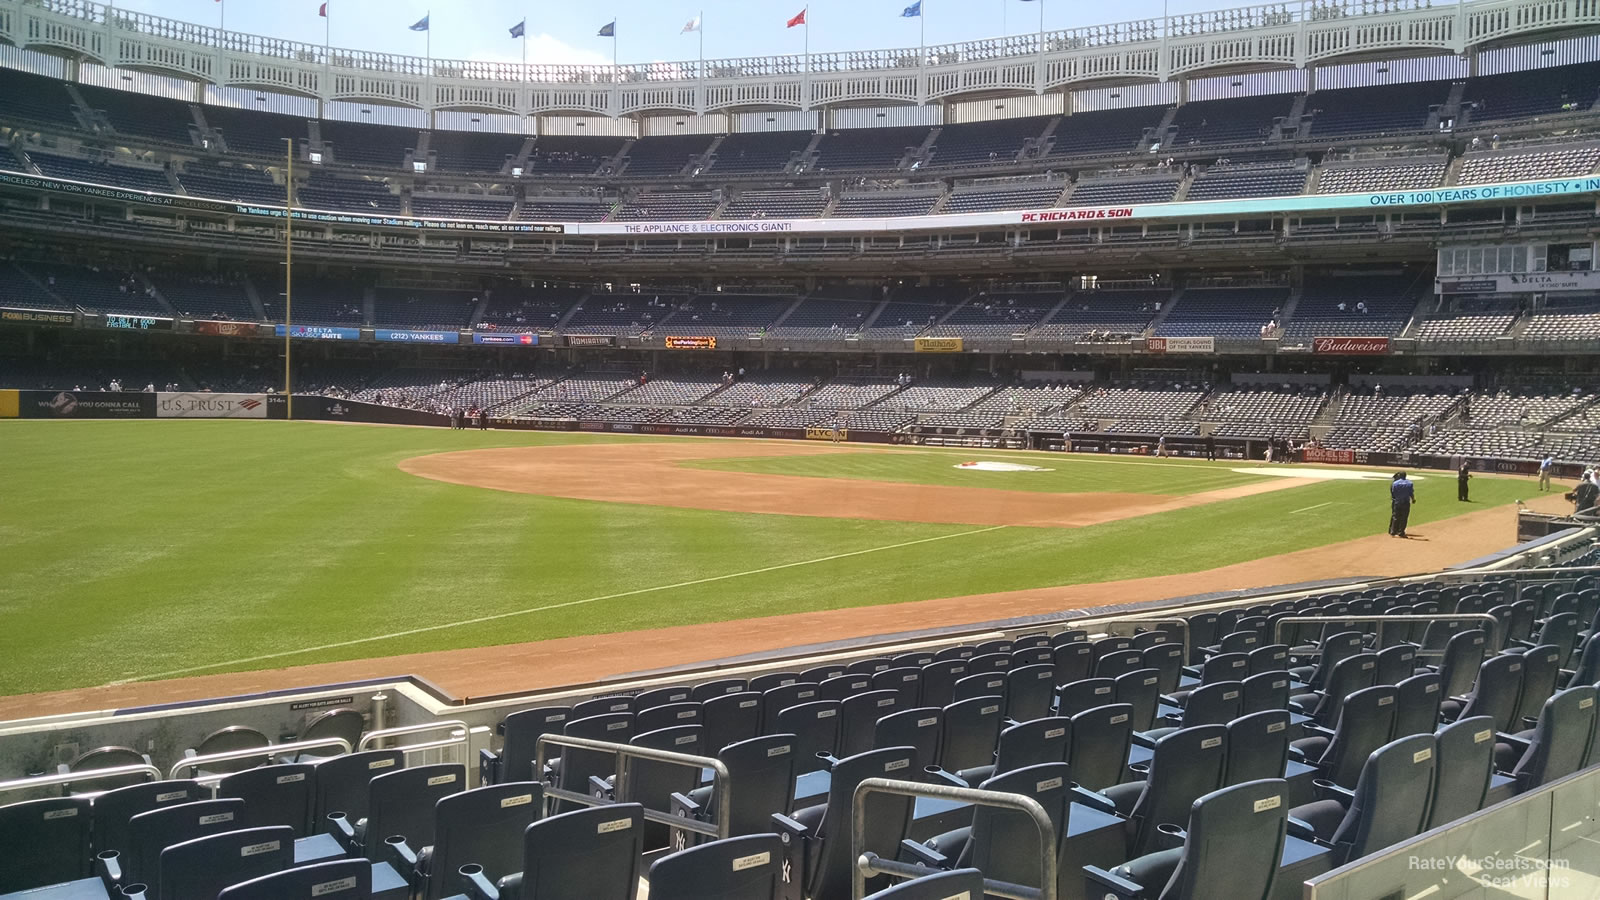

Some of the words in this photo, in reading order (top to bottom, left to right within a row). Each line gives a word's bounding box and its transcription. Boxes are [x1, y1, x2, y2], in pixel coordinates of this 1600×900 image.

[42, 180, 61, 189] NEW
[62, 182, 82, 192] YORK
[83, 185, 116, 198] YANKEES
[116, 191, 163, 204] EXPERIENCES
[163, 198, 173, 206] AT
[1370, 194, 1405, 206] OVER
[1408, 192, 1431, 204] 100
[1436, 189, 1477, 202] YEARS
[1481, 187, 1500, 199] OF
[1503, 181, 1570, 198] HONESTY
[236, 205, 248, 214] The
[248, 206, 270, 216] Yankees
[270, 209, 282, 218] urge
[308, 212, 318, 220] use
[318, 213, 337, 222] caution
[338, 214, 352, 223] when
[352, 216, 370, 225] moving
[382, 217, 404, 226] Stadium
[423, 220, 440, 229] Please
[1039, 210, 1096, 222] RICHARD
[1096, 208, 1106, 219] &
[1107, 208, 1133, 218] SON
[624, 224, 641, 233] THE
[643, 224, 690, 233] APPLIANCE
[692, 224, 698, 232] &
[700, 222, 759, 233] ELECTRONICS
[761, 222, 792, 232] GIANT!
[1522, 276, 1552, 284] DELTA
[23, 312, 73, 323] BUSINESS
[390, 332, 409, 341] (212)
[1149, 340, 1166, 350] JBL
[1314, 338, 1388, 352] Budweiser
[162, 400, 185, 412] U.S.
[189, 400, 235, 412] TRUST
[807, 429, 846, 437] PLYCN
